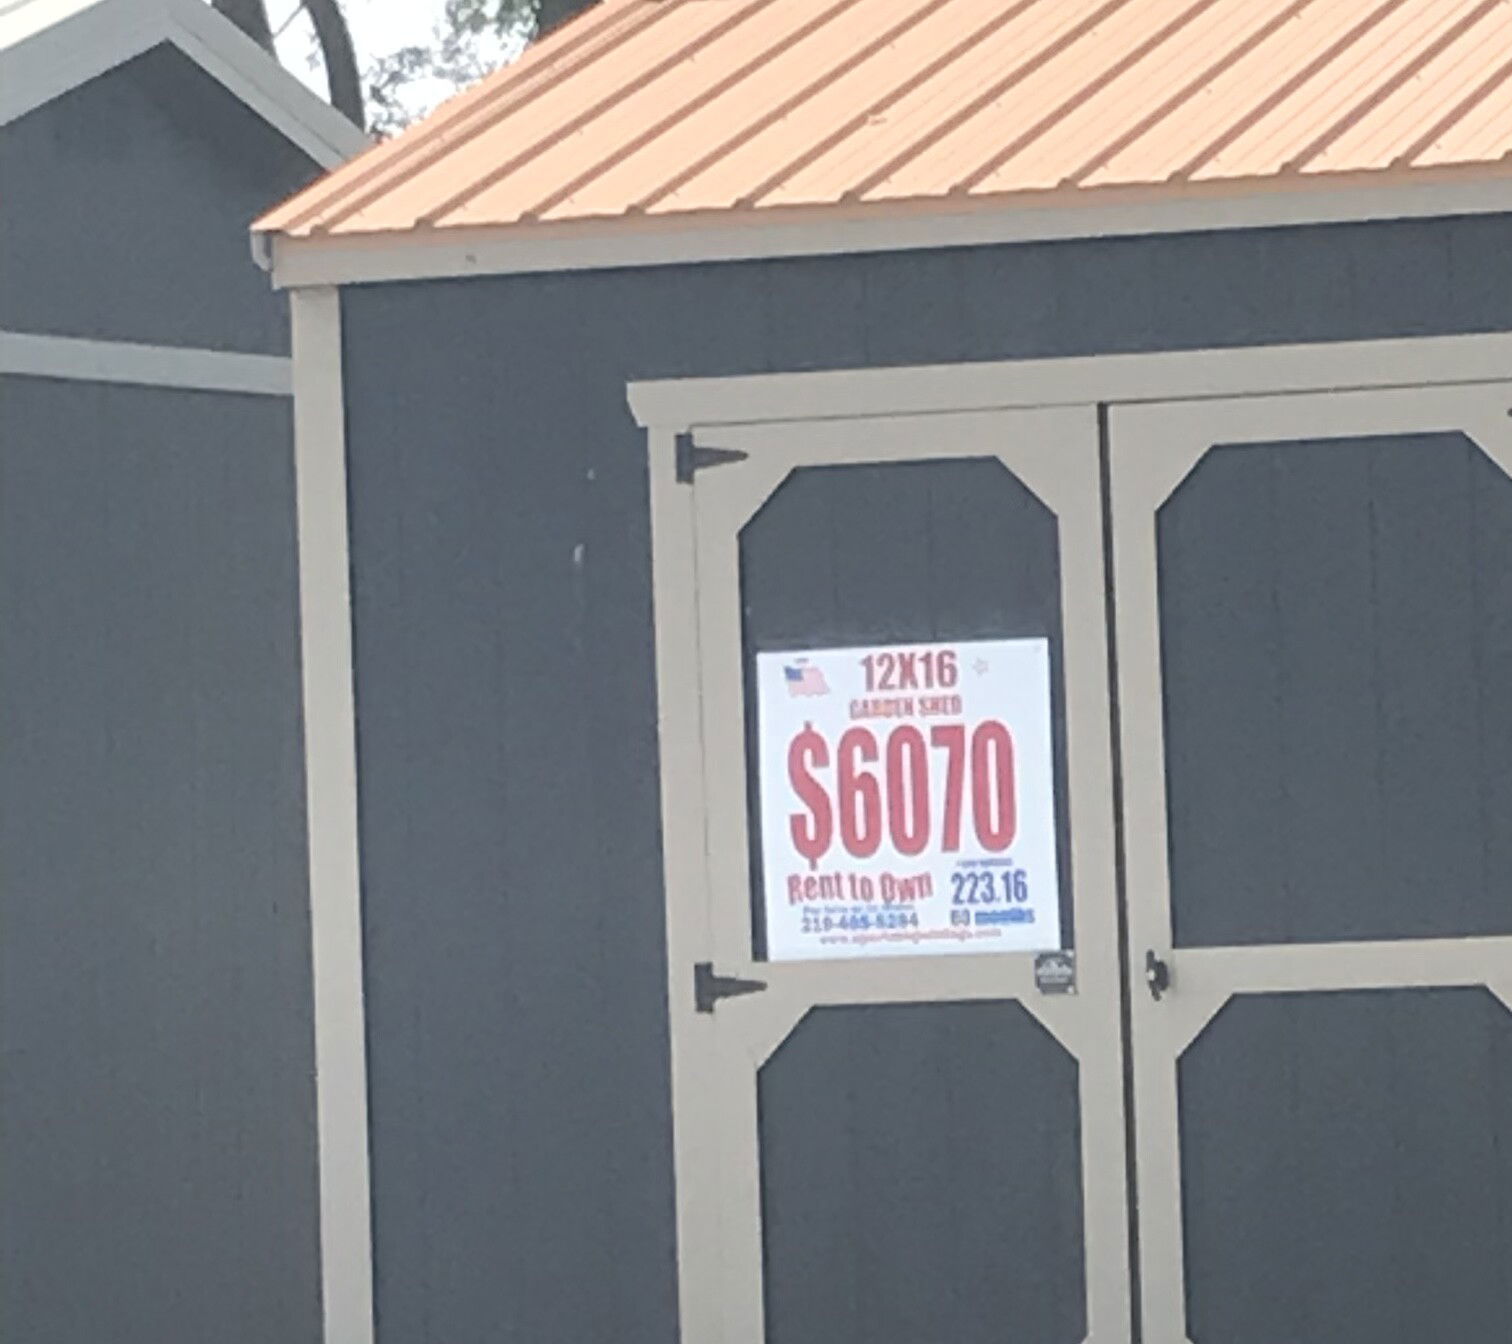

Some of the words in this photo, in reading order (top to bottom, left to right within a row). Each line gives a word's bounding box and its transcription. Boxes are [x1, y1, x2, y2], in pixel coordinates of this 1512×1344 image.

[860, 650, 958, 692] 12X16
[850, 697, 913, 720] GARDEN
[918, 694, 962, 716] SHED
[787, 720, 1017, 871] $6070
[787, 872, 844, 905] Rent
[850, 872, 874, 903] to
[880, 871, 934, 904] Own
[951, 869, 1028, 905] 223.16
